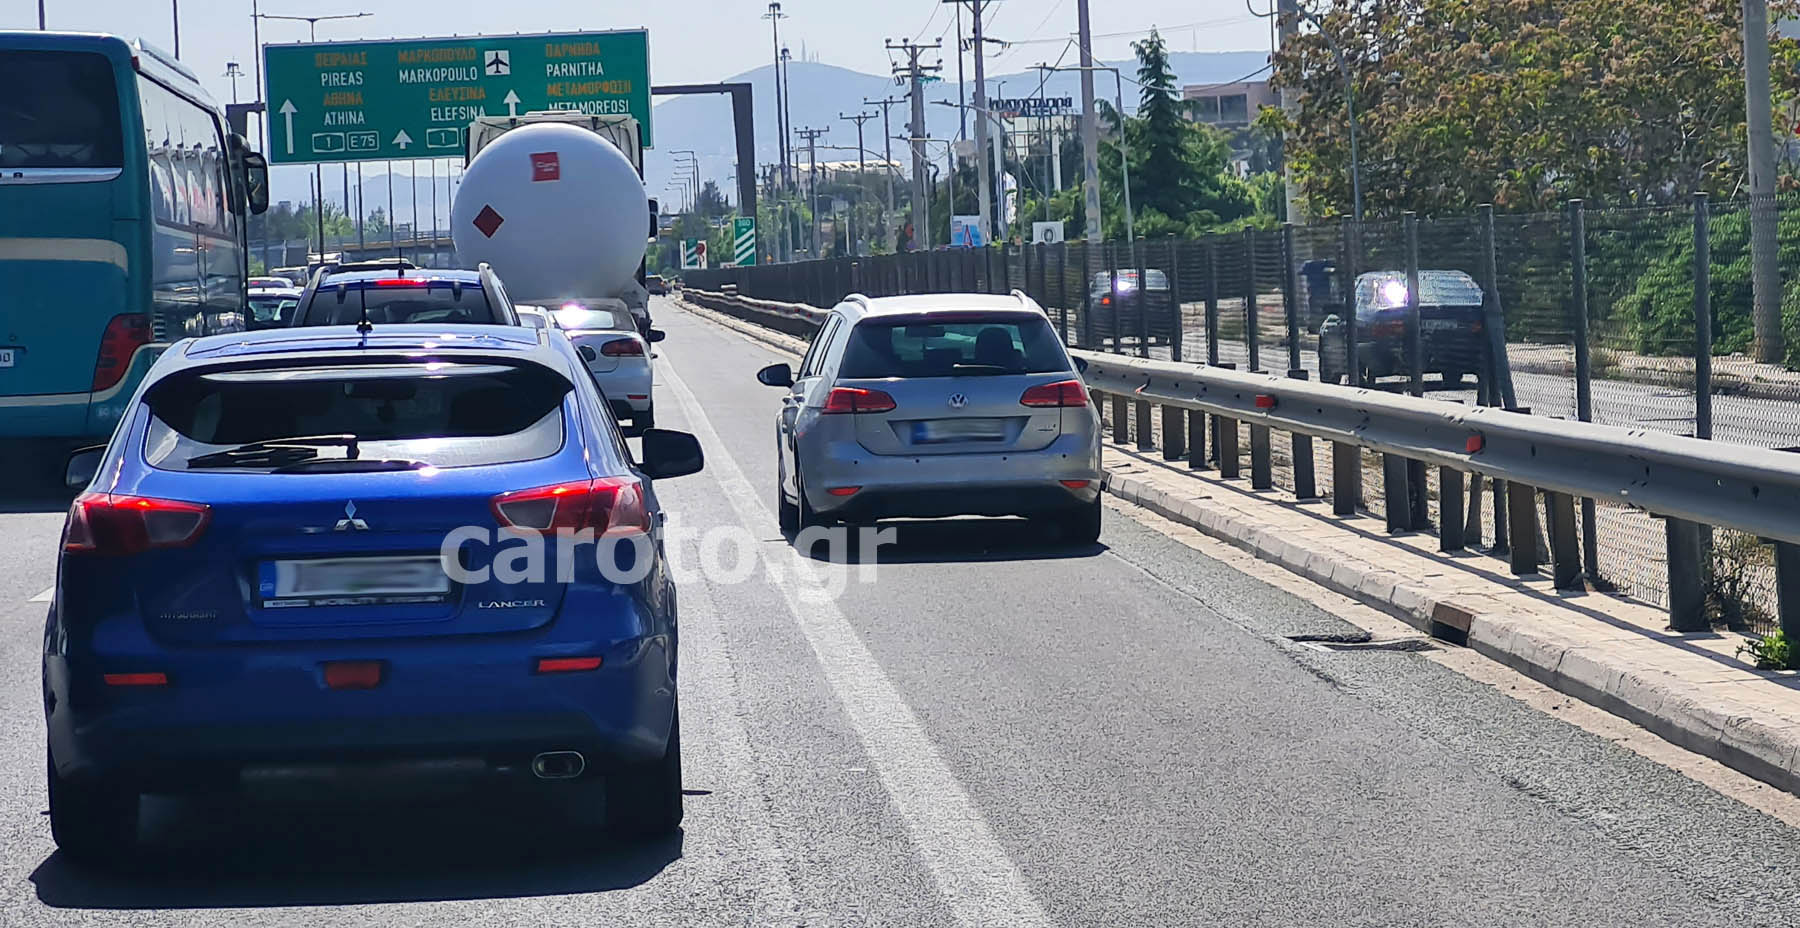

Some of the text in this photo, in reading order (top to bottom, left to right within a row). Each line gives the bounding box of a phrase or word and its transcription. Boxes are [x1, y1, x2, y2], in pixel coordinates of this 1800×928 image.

[399, 66, 478, 83] MARKOPOULO
[546, 61, 604, 77] PARNITHA
[321, 71, 364, 87] PIREAS
[323, 91, 363, 107] ΑΘΗΝΑ
[429, 86, 486, 102] ΕΛΕΥΣΙΝΑ
[324, 111, 365, 126] ATHINA
[431, 105, 486, 121] ELEFSINA
[325, 136, 332, 148] 1
[439, 132, 446, 144] 1
[478, 599, 545, 609] LANCER
